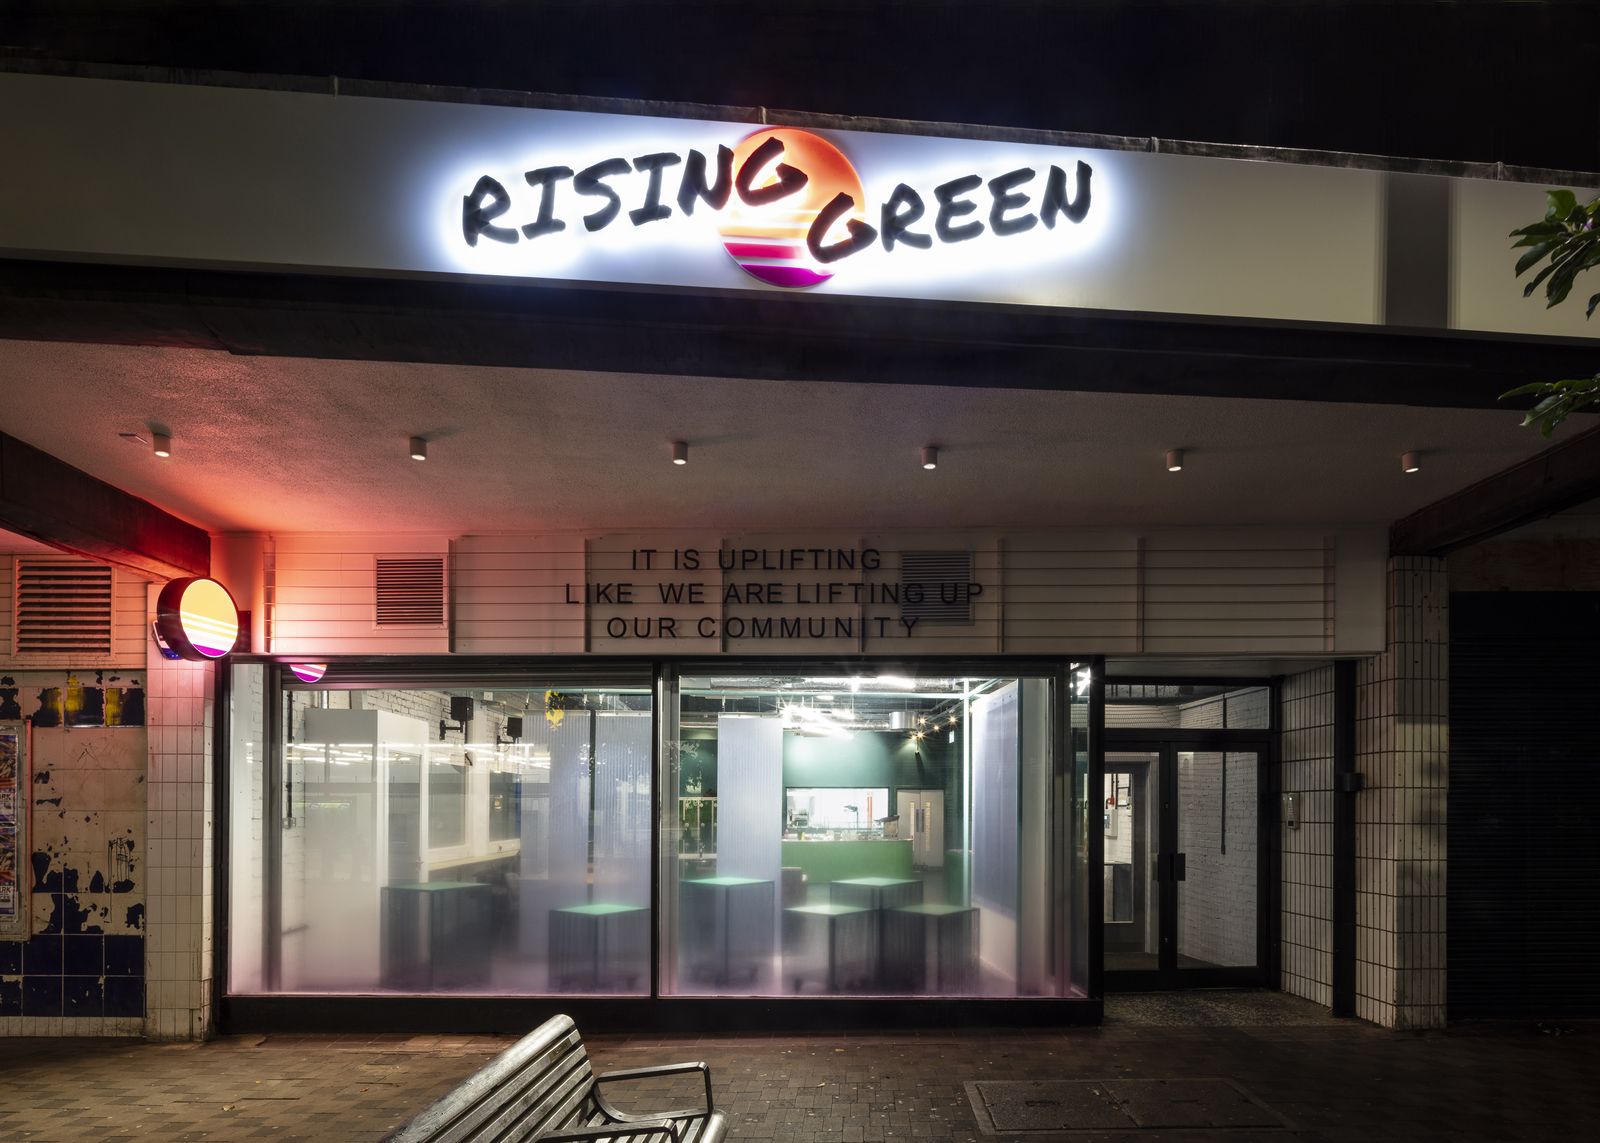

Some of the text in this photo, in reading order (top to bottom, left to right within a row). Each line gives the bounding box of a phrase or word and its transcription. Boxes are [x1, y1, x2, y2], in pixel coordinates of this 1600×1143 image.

[462, 136, 808, 248] RISING
[806, 159, 1093, 264] GREEN
[631, 549, 881, 570] IT IS UPLIFTING
[565, 583, 984, 604] LIKE WE ARE LIFTING UP
[606, 617, 920, 639] OUR COMMUNITY
